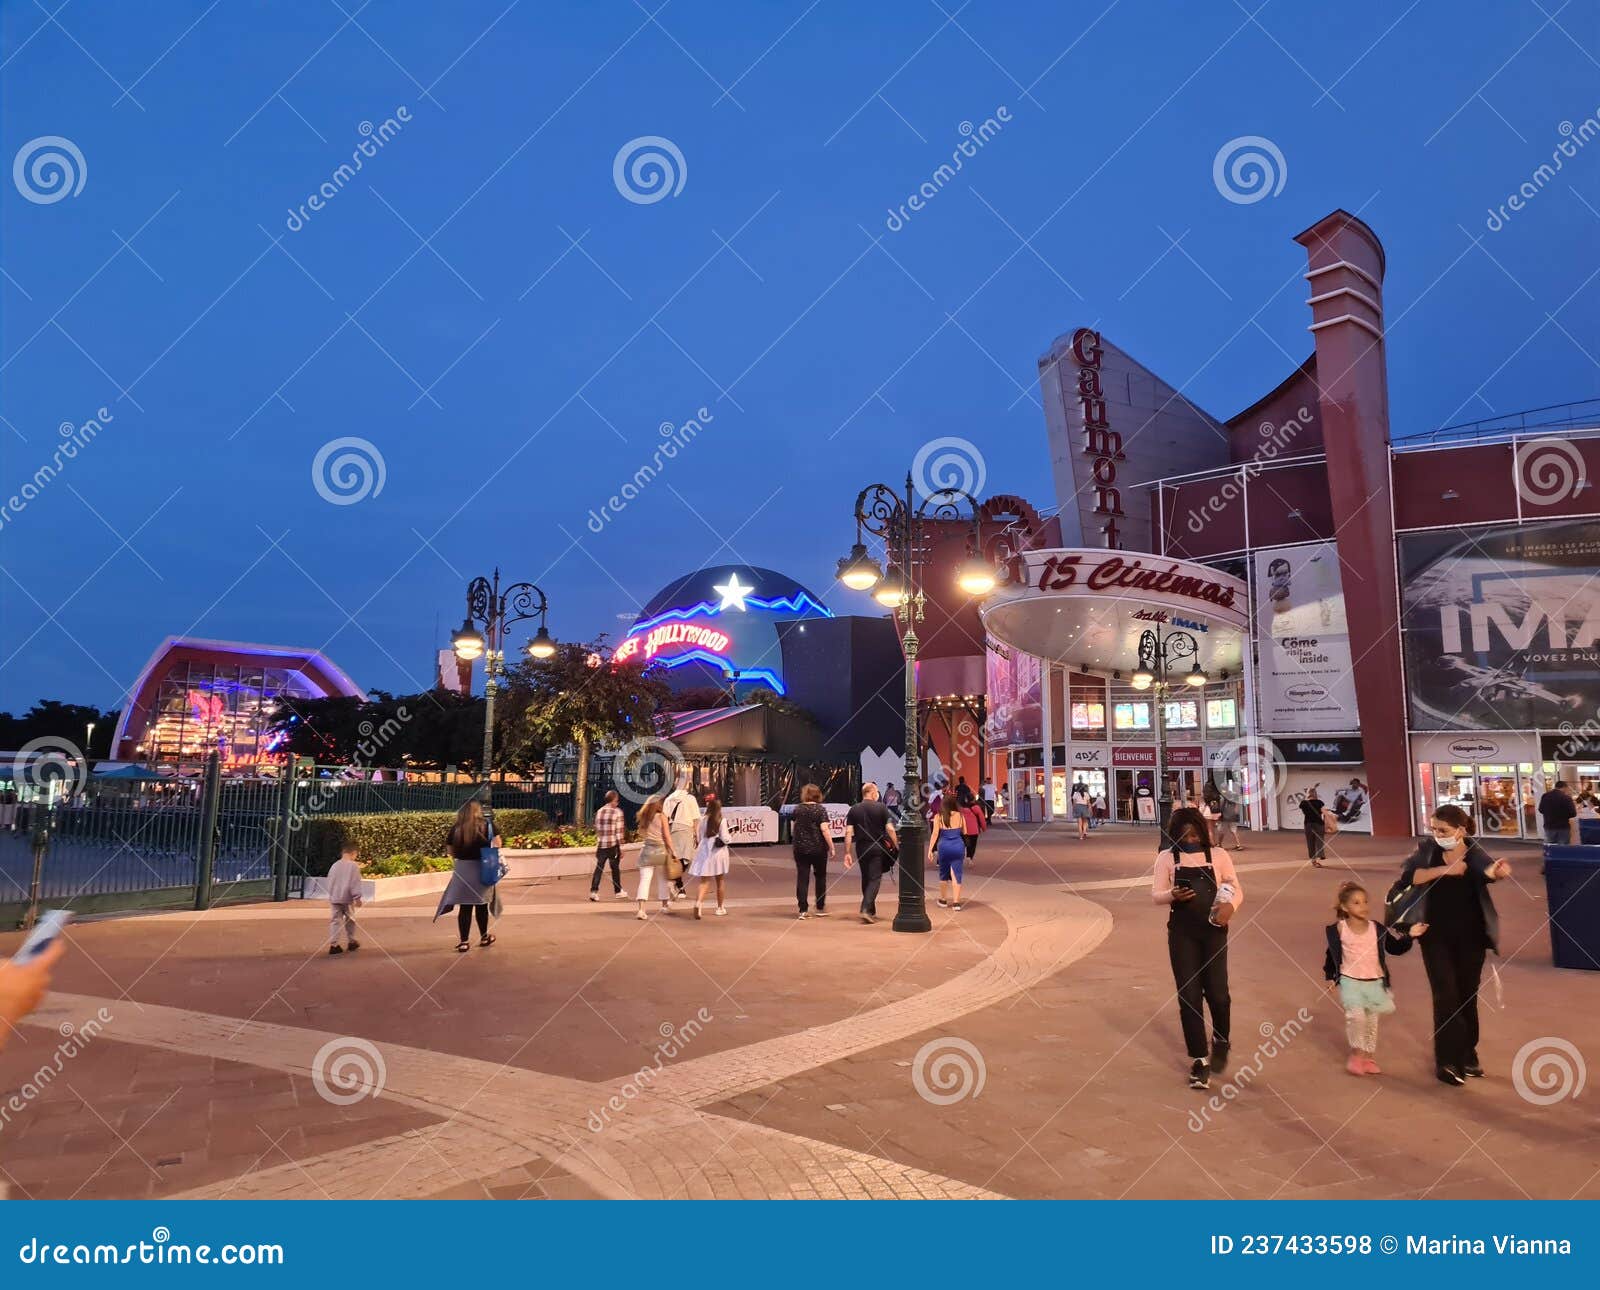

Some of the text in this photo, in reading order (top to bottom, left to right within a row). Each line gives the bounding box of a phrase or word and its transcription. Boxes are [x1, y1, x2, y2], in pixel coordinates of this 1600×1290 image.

[1072, 328, 1126, 550] Gaumont
[1039, 555, 1082, 592] 15
[1088, 556, 1236, 609] Cinémas
[1171, 617, 1208, 632] IMAX
[644, 624, 729, 658] HOLLYWOOD
[1299, 654, 1329, 663] inside
[1522, 653, 1600, 662] VOYEZ PLU
[1297, 743, 1340, 752] IMAX
[1075, 750, 1100, 761] 4DX
[1115, 752, 1154, 761] BIENVENUE
